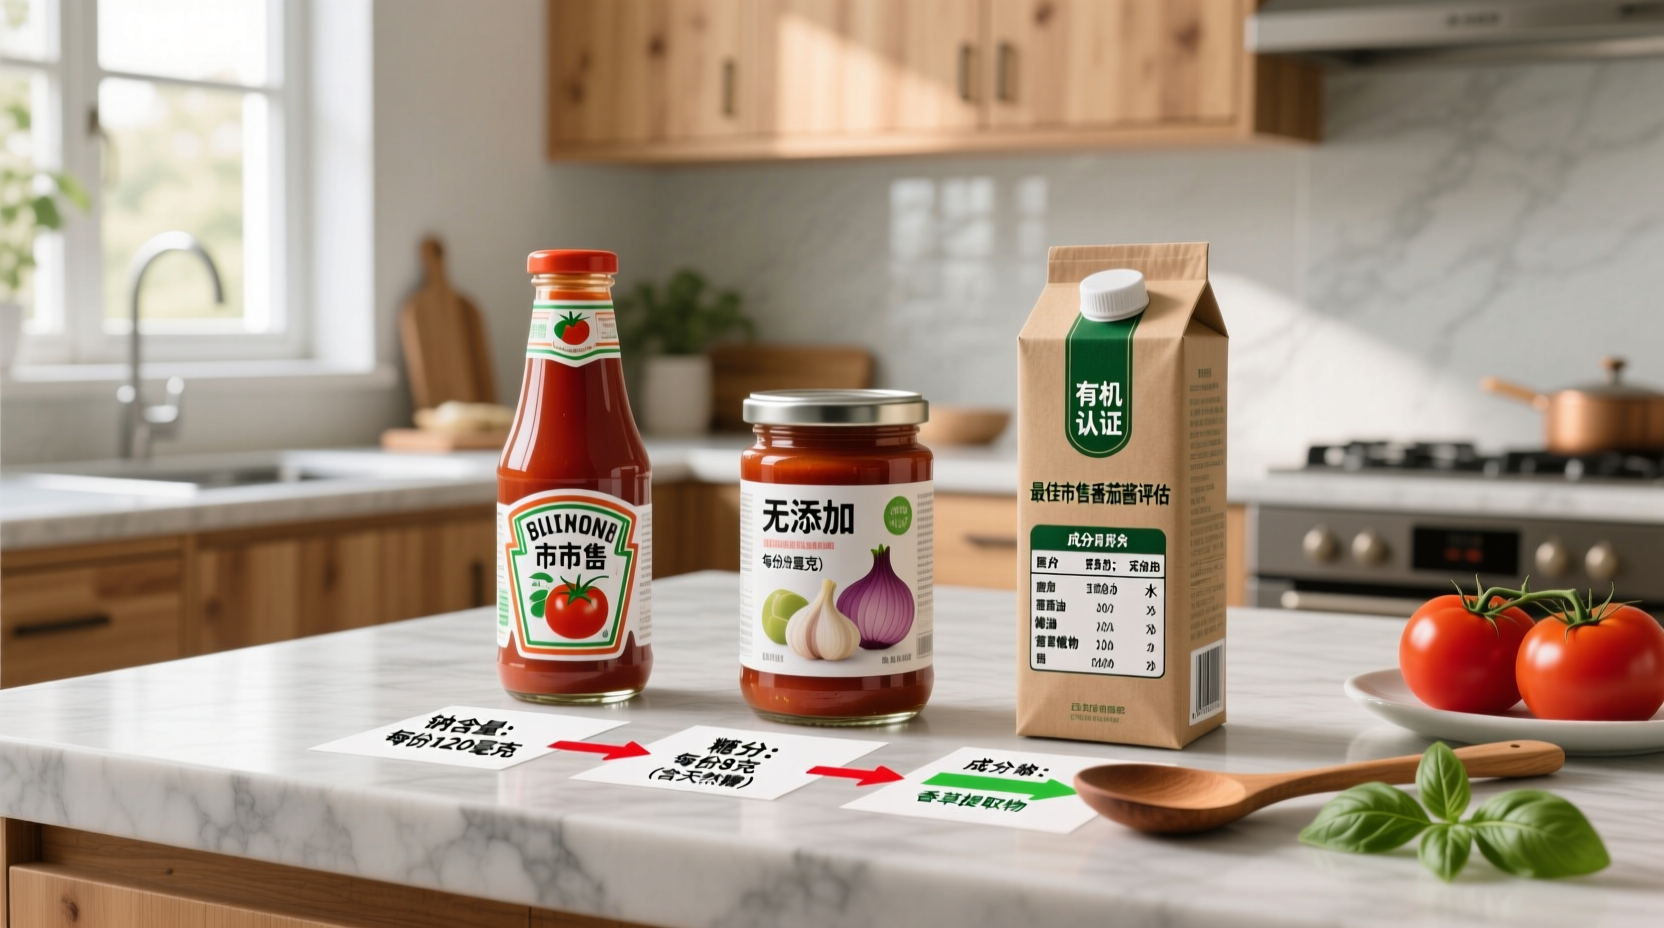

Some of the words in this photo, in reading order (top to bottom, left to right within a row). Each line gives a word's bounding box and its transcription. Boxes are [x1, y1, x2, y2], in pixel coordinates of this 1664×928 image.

[1076, 380, 1123, 407] 有机
[1076, 410, 1123, 436] 认证
[1030, 481, 1171, 506] 最佳市售番茄酱评估
[762, 499, 854, 535] 无添加
[917, 790, 1028, 812] 香草提取物
